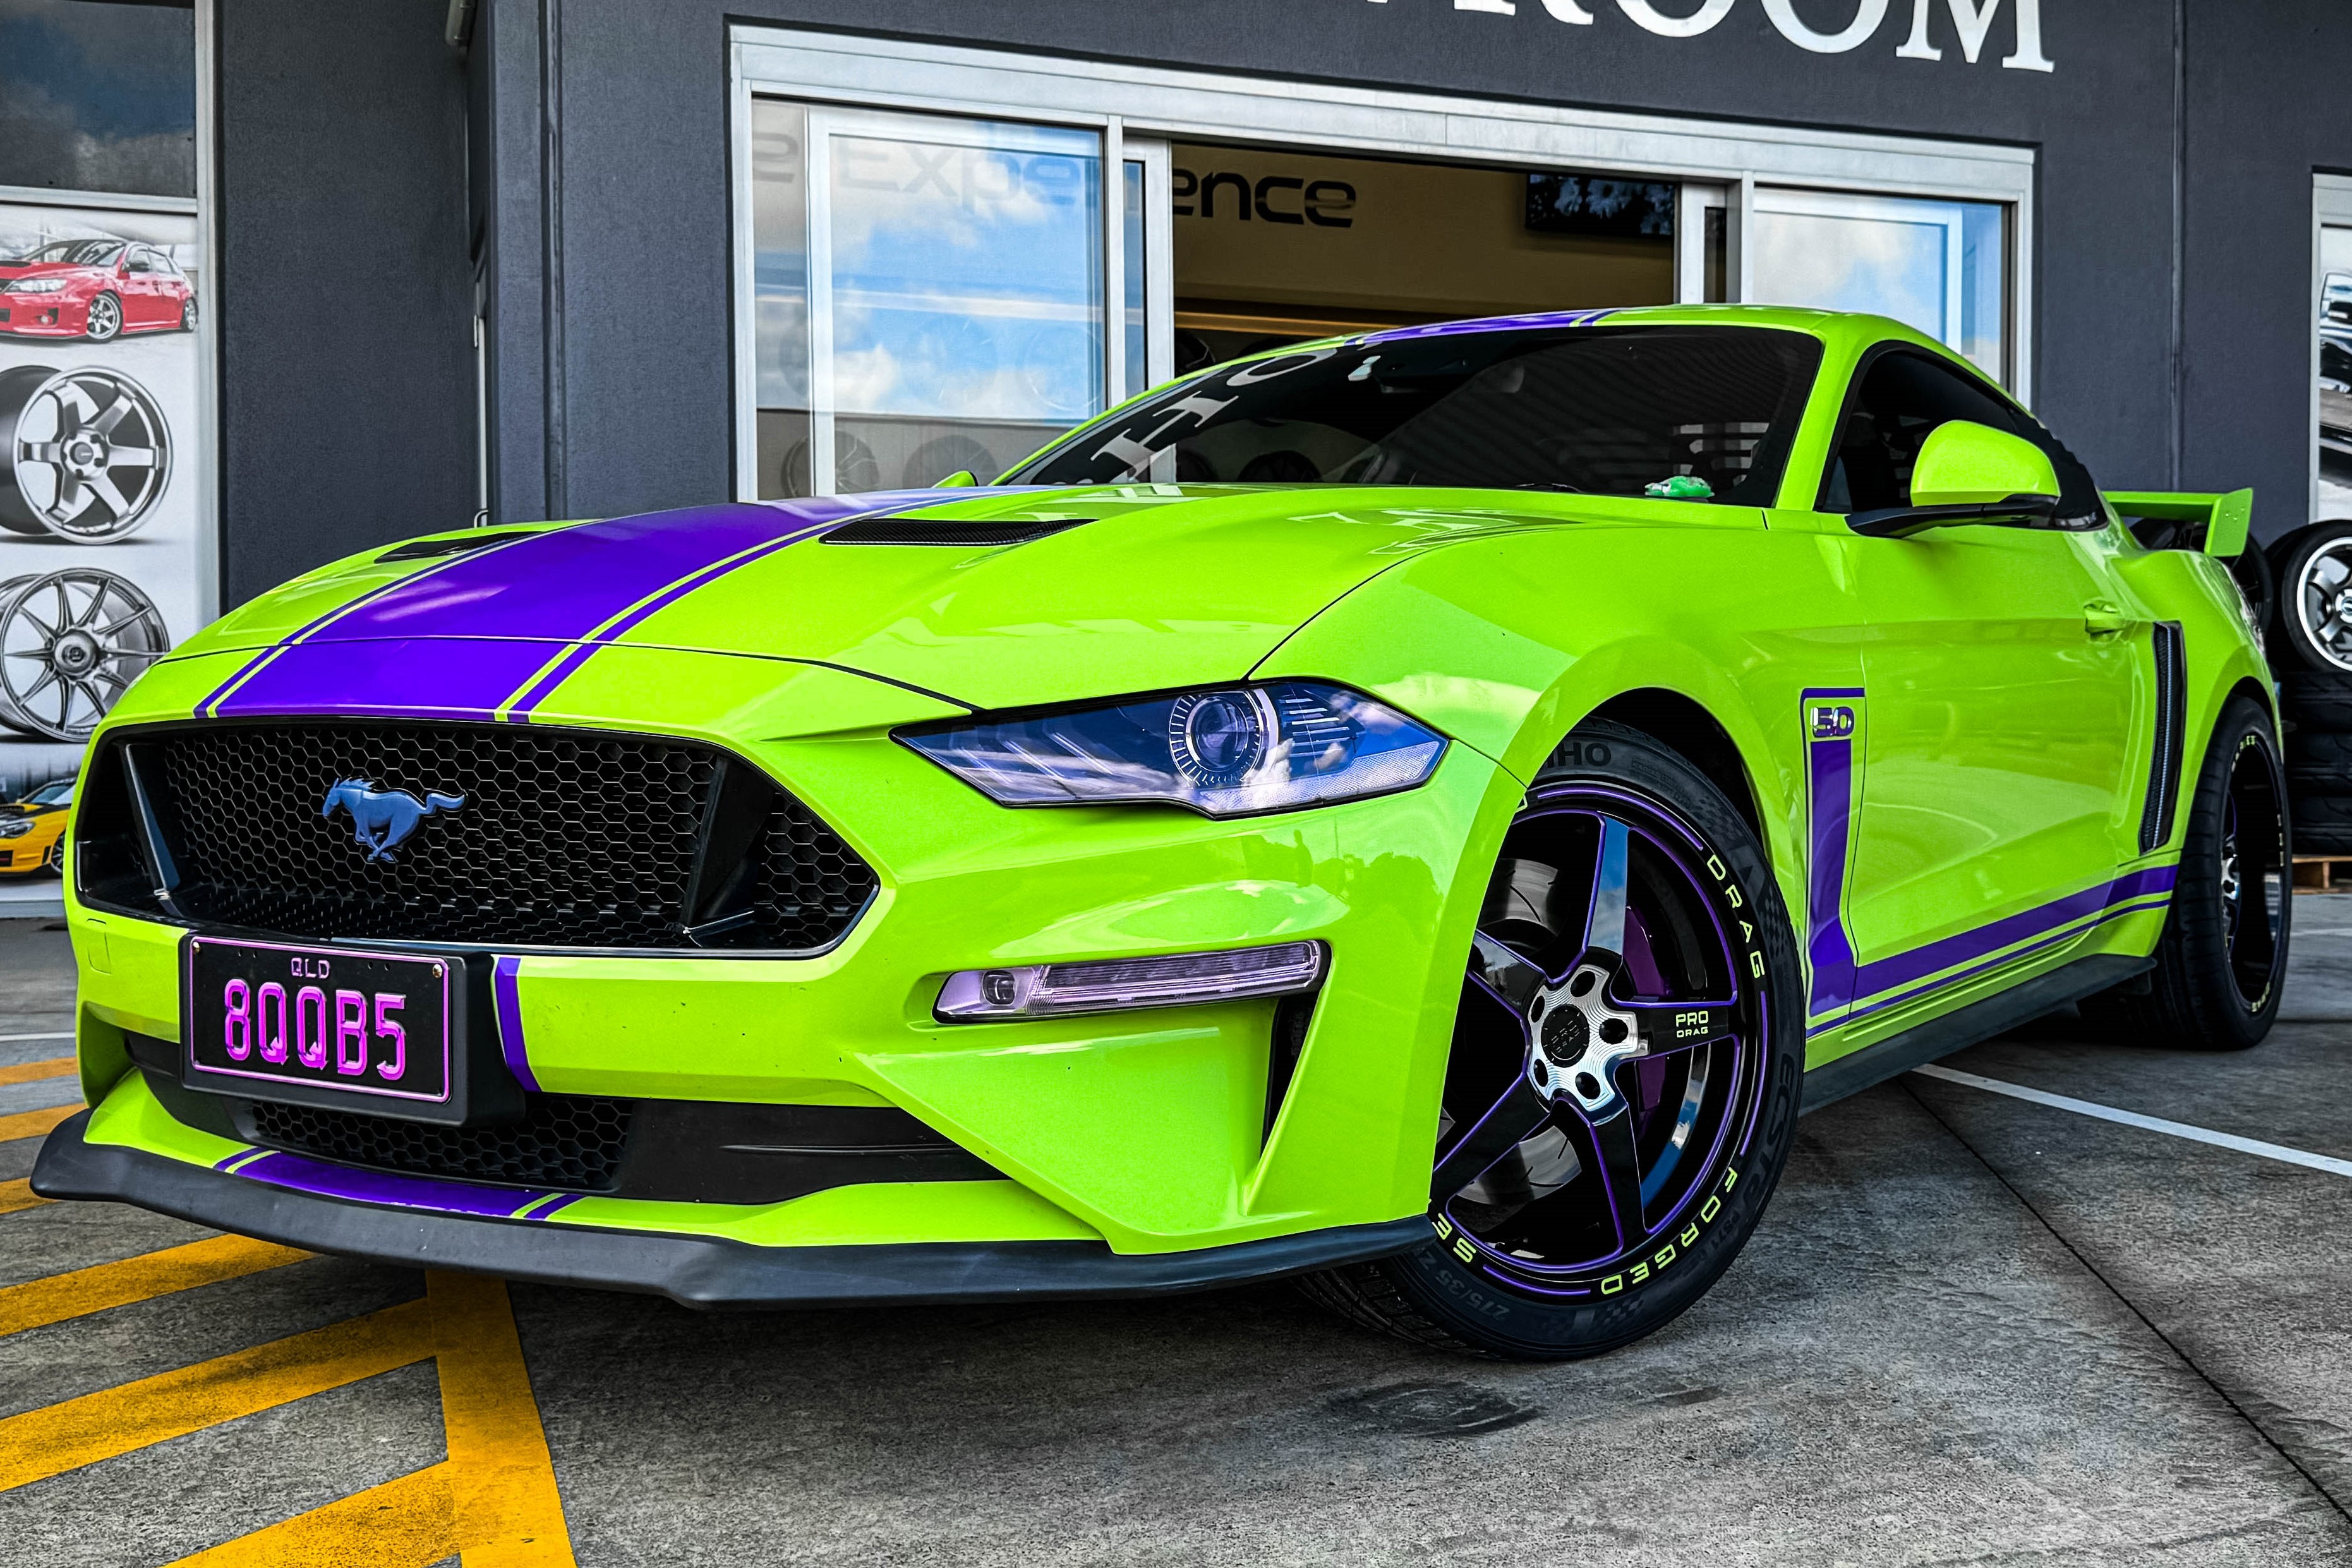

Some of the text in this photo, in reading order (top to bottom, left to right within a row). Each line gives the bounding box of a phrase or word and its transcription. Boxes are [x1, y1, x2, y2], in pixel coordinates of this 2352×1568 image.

[1706, 853, 1765, 979] DRAG
[291, 957, 330, 979] QLD
[224, 979, 407, 1080] 8QQB5
[1675, 1010, 1709, 1027] PRO
[1676, 1026, 1708, 1038] DRAG
[1601, 1166, 1739, 1295] FORGED
